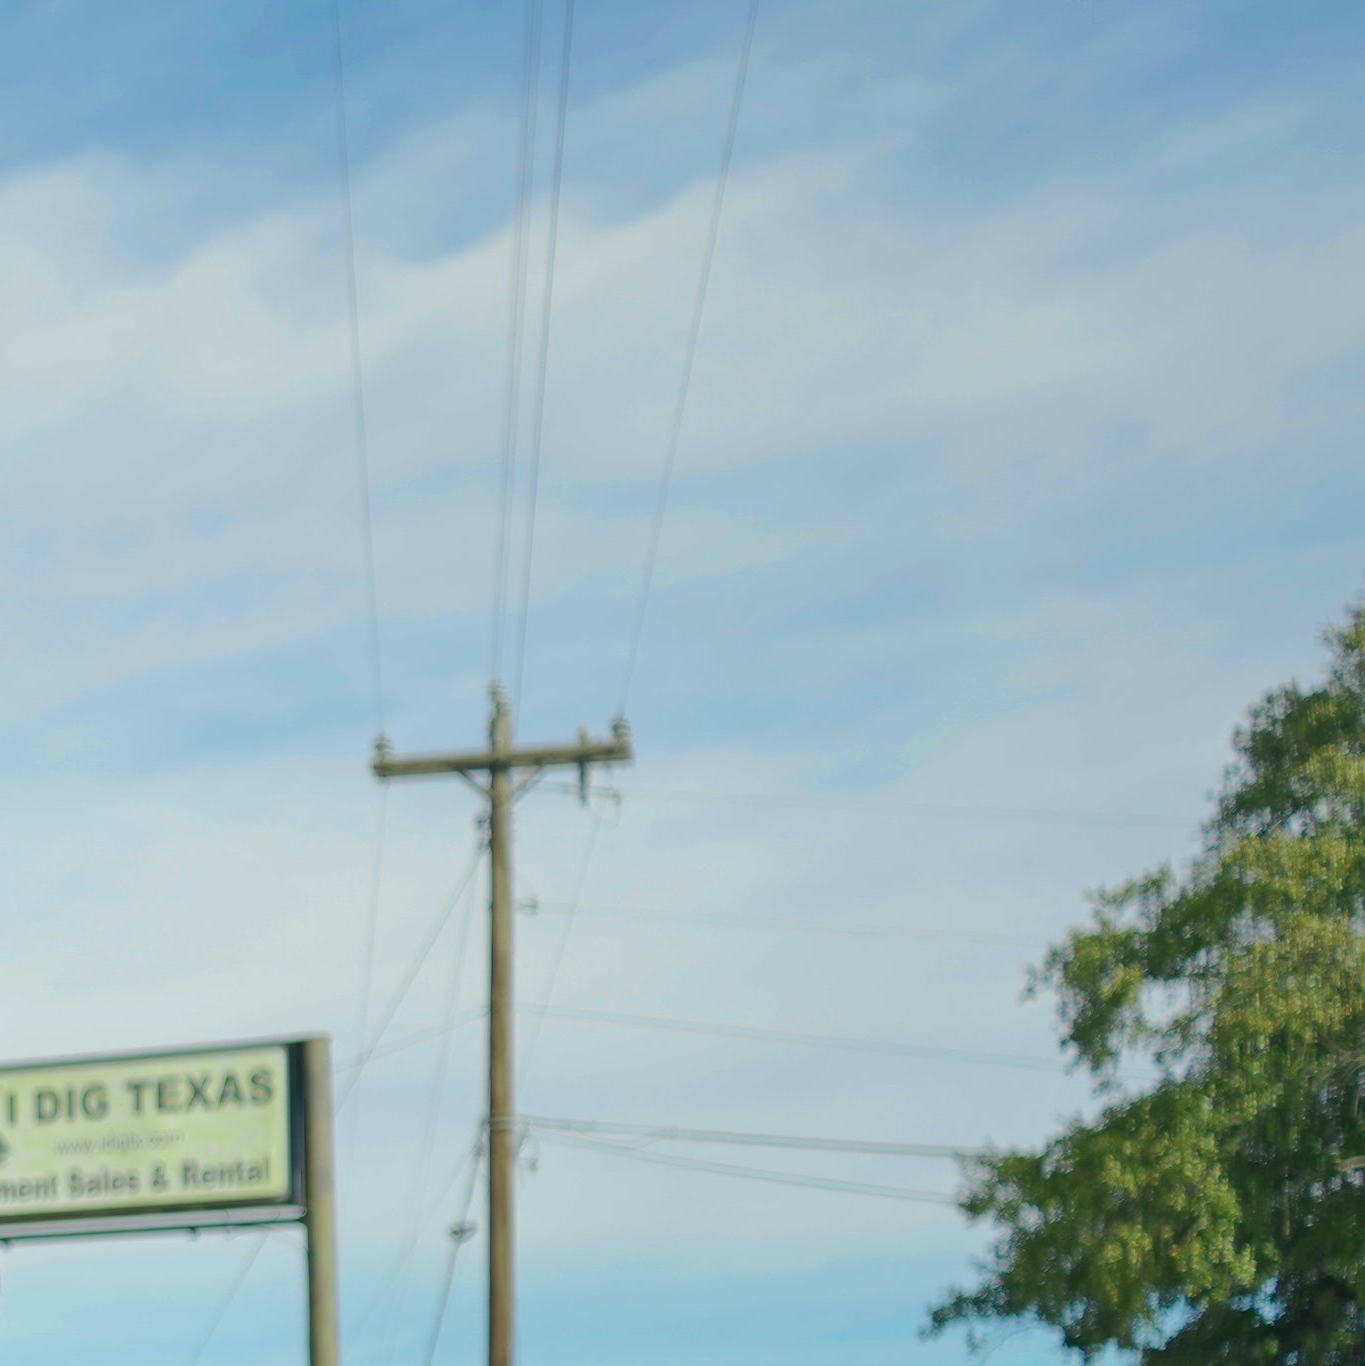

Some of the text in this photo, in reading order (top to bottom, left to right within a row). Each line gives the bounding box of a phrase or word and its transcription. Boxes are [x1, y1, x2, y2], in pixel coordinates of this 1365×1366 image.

[6, 1066, 275, 1126] I DIG TEXAS
[68, 1165, 140, 1198] Sales
[150, 1164, 169, 1191] &
[181, 1154, 271, 1189] Rental
